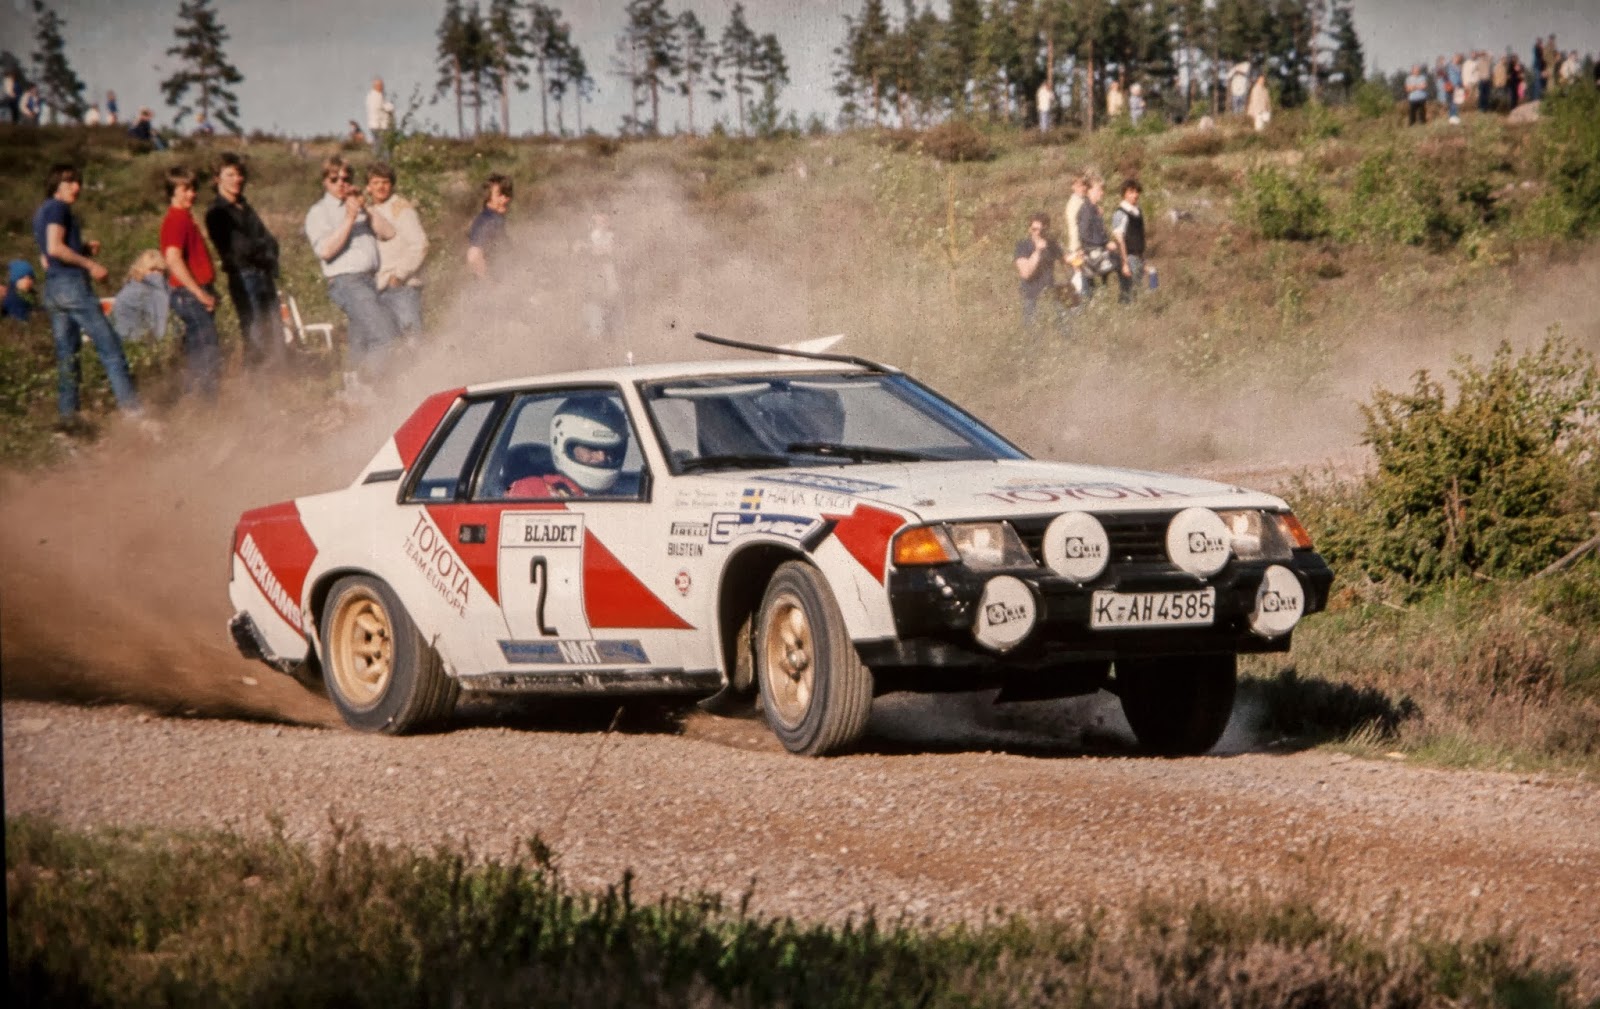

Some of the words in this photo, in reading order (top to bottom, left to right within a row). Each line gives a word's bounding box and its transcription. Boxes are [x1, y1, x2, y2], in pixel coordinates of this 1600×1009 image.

[412, 510, 471, 601] TOYOTA
[524, 525, 577, 542] BLADET
[667, 542, 704, 557] BILSTEIN
[670, 522, 709, 536] PIRELLI
[239, 533, 302, 628] DUCKHAMS
[403, 536, 427, 576] TEAM
[424, 566, 467, 618] EUROPE
[530, 556, 559, 637] 2
